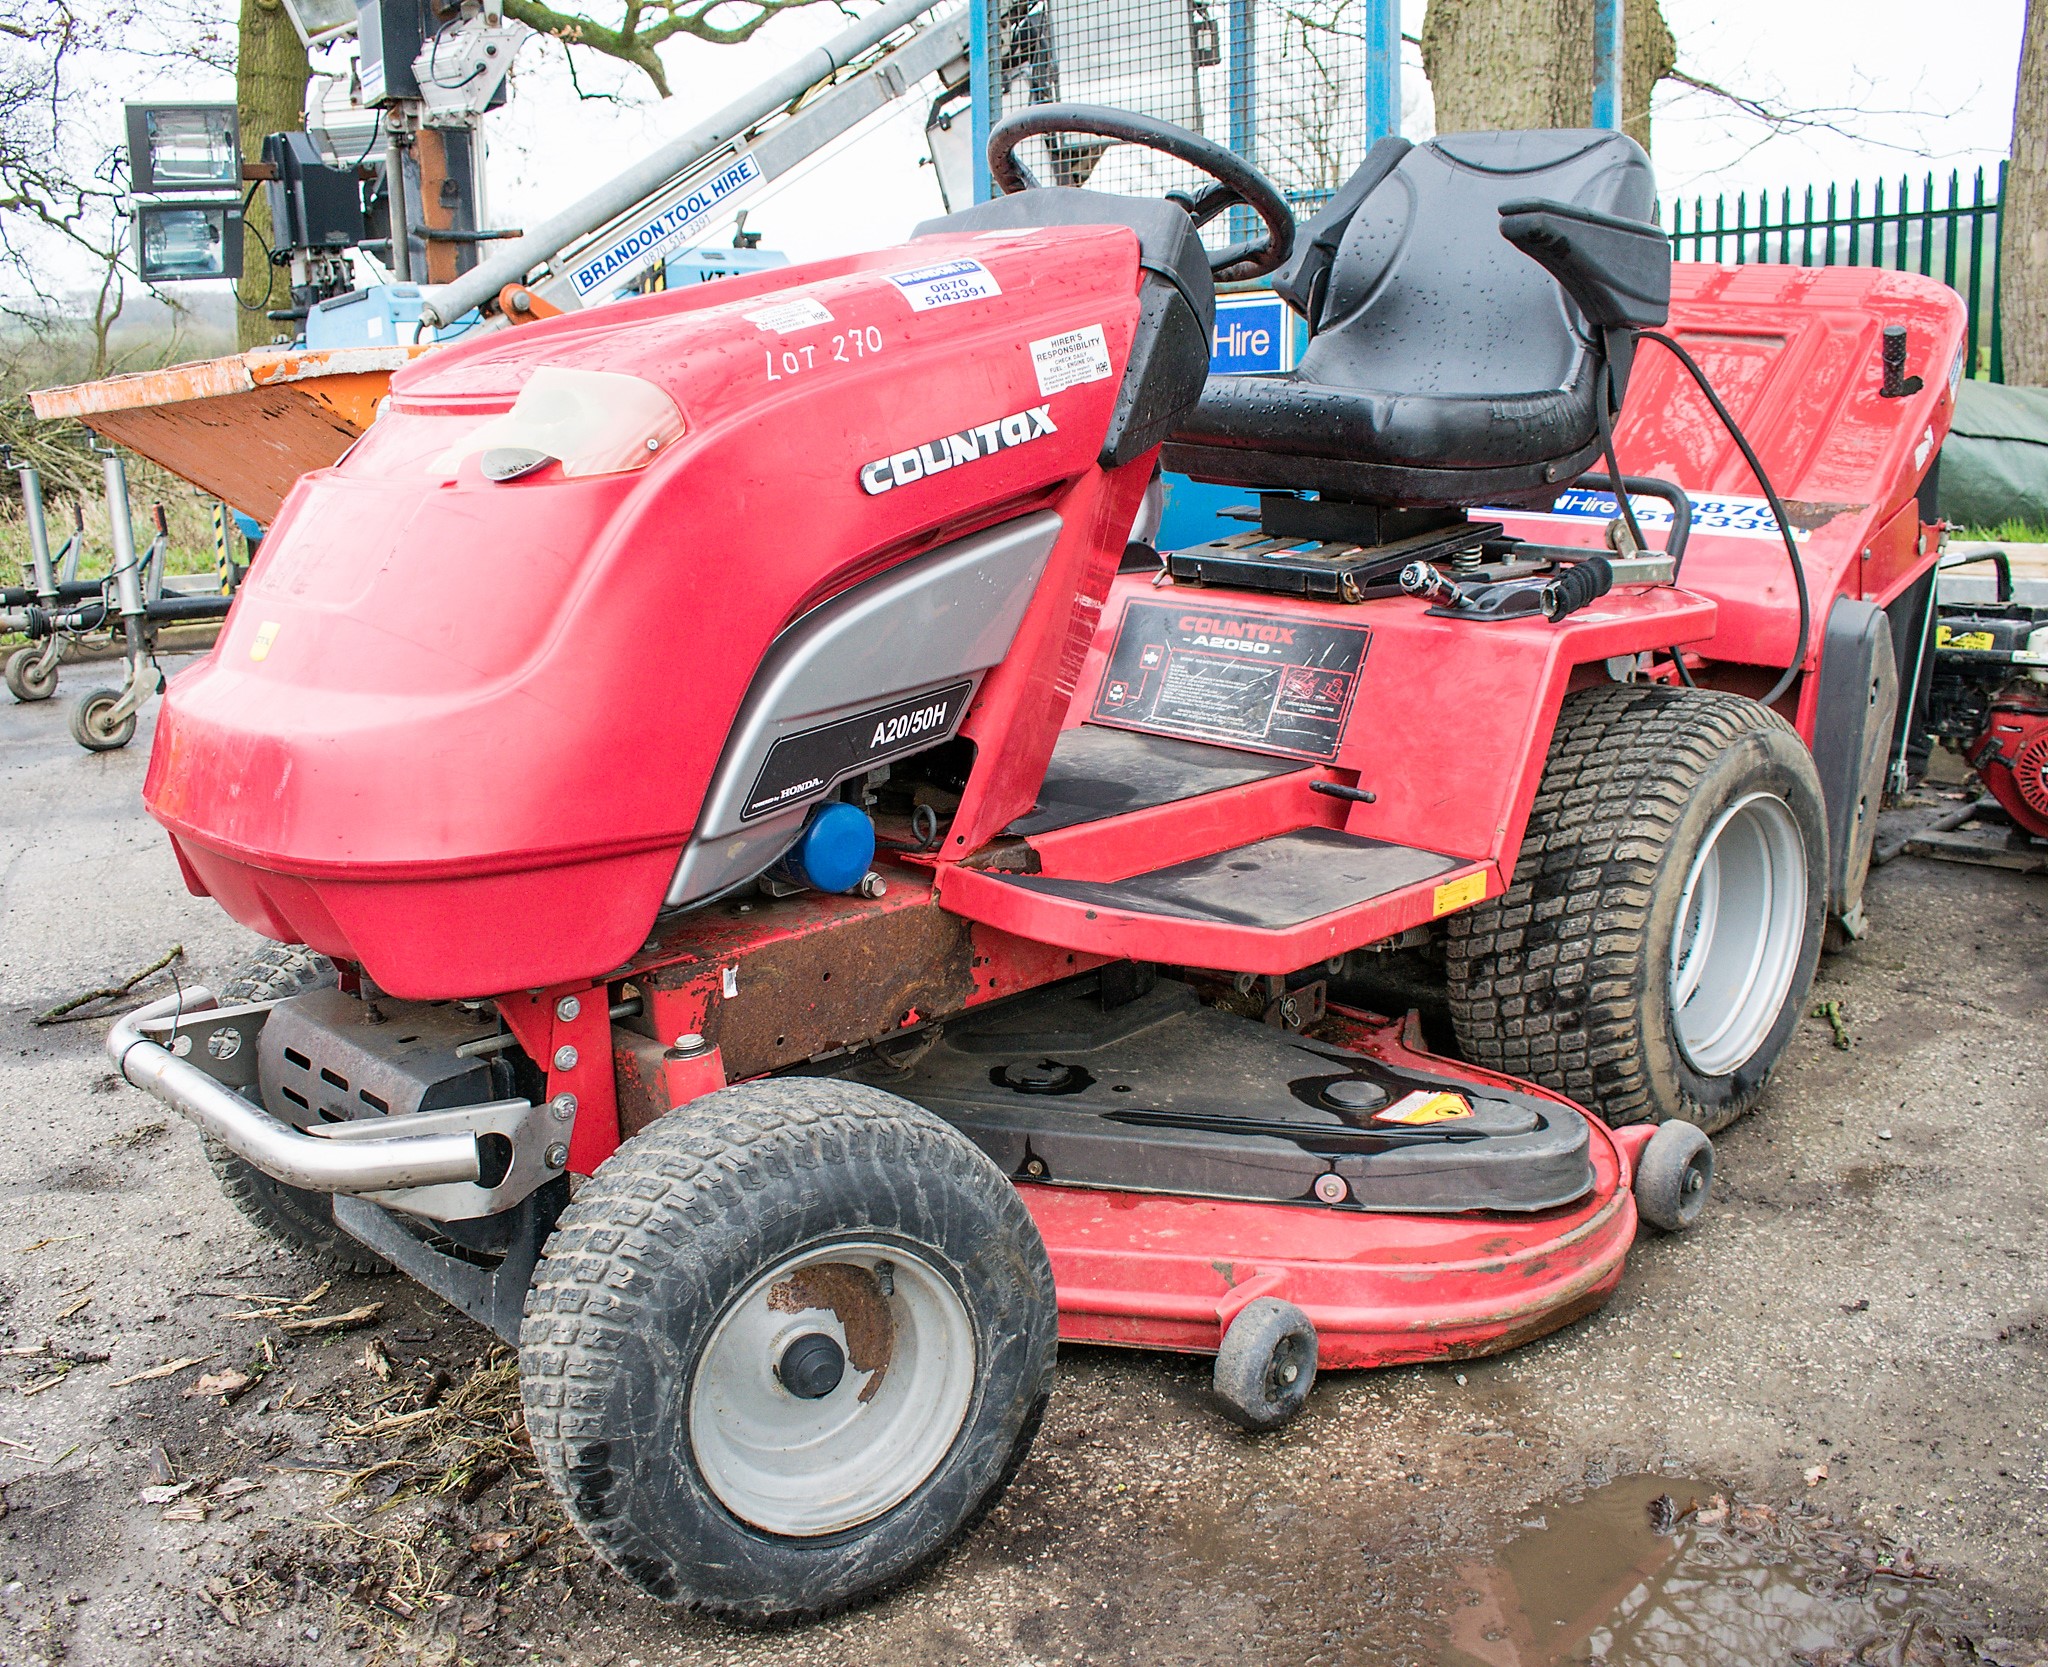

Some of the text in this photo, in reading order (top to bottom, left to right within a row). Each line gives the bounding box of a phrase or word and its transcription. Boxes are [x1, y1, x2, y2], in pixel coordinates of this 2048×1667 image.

[578, 162, 752, 290] BRANDON TOOL HIRE
[642, 214, 711, 267] 0870 514 3391
[925, 285, 987, 306] 5143391
[930, 278, 969, 293] 0870
[766, 325, 883, 381] LOT 270
[1036, 337, 1100, 362] RESPONSIBILITY
[1050, 333, 1083, 348] HIRER'S
[1212, 323, 1270, 358] Hire
[1566, 495, 1618, 513] Hire
[869, 701, 949, 749] A20/50H
[780, 777, 821, 799] HONDA
